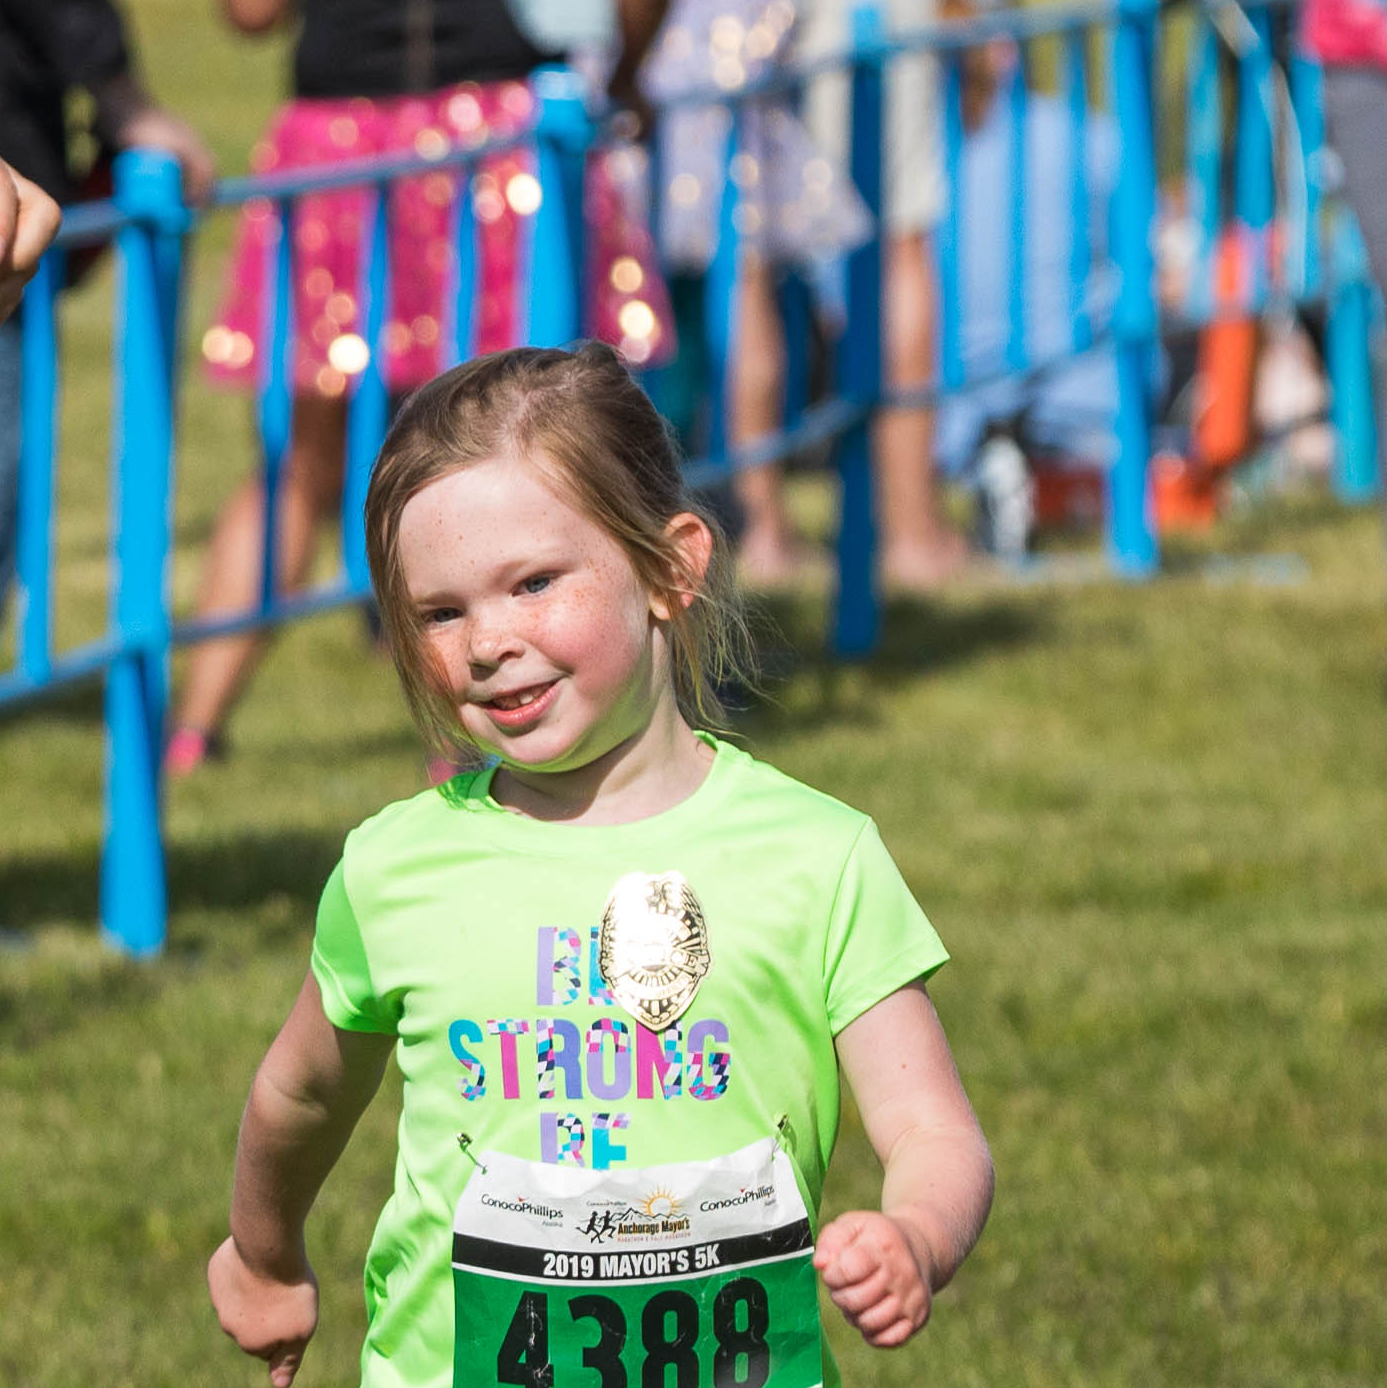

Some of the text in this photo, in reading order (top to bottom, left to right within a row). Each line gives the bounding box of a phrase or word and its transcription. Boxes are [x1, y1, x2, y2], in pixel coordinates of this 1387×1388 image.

[448, 1018, 732, 1102] STRONG
[481, 1194, 563, 1219] ConocoPhillips
[700, 1184, 775, 1213] ConocoPhillips
[618, 1217, 690, 1235] Anchorage Mayor's
[543, 1244, 721, 1278] 2019 MAYOR'S 5K
